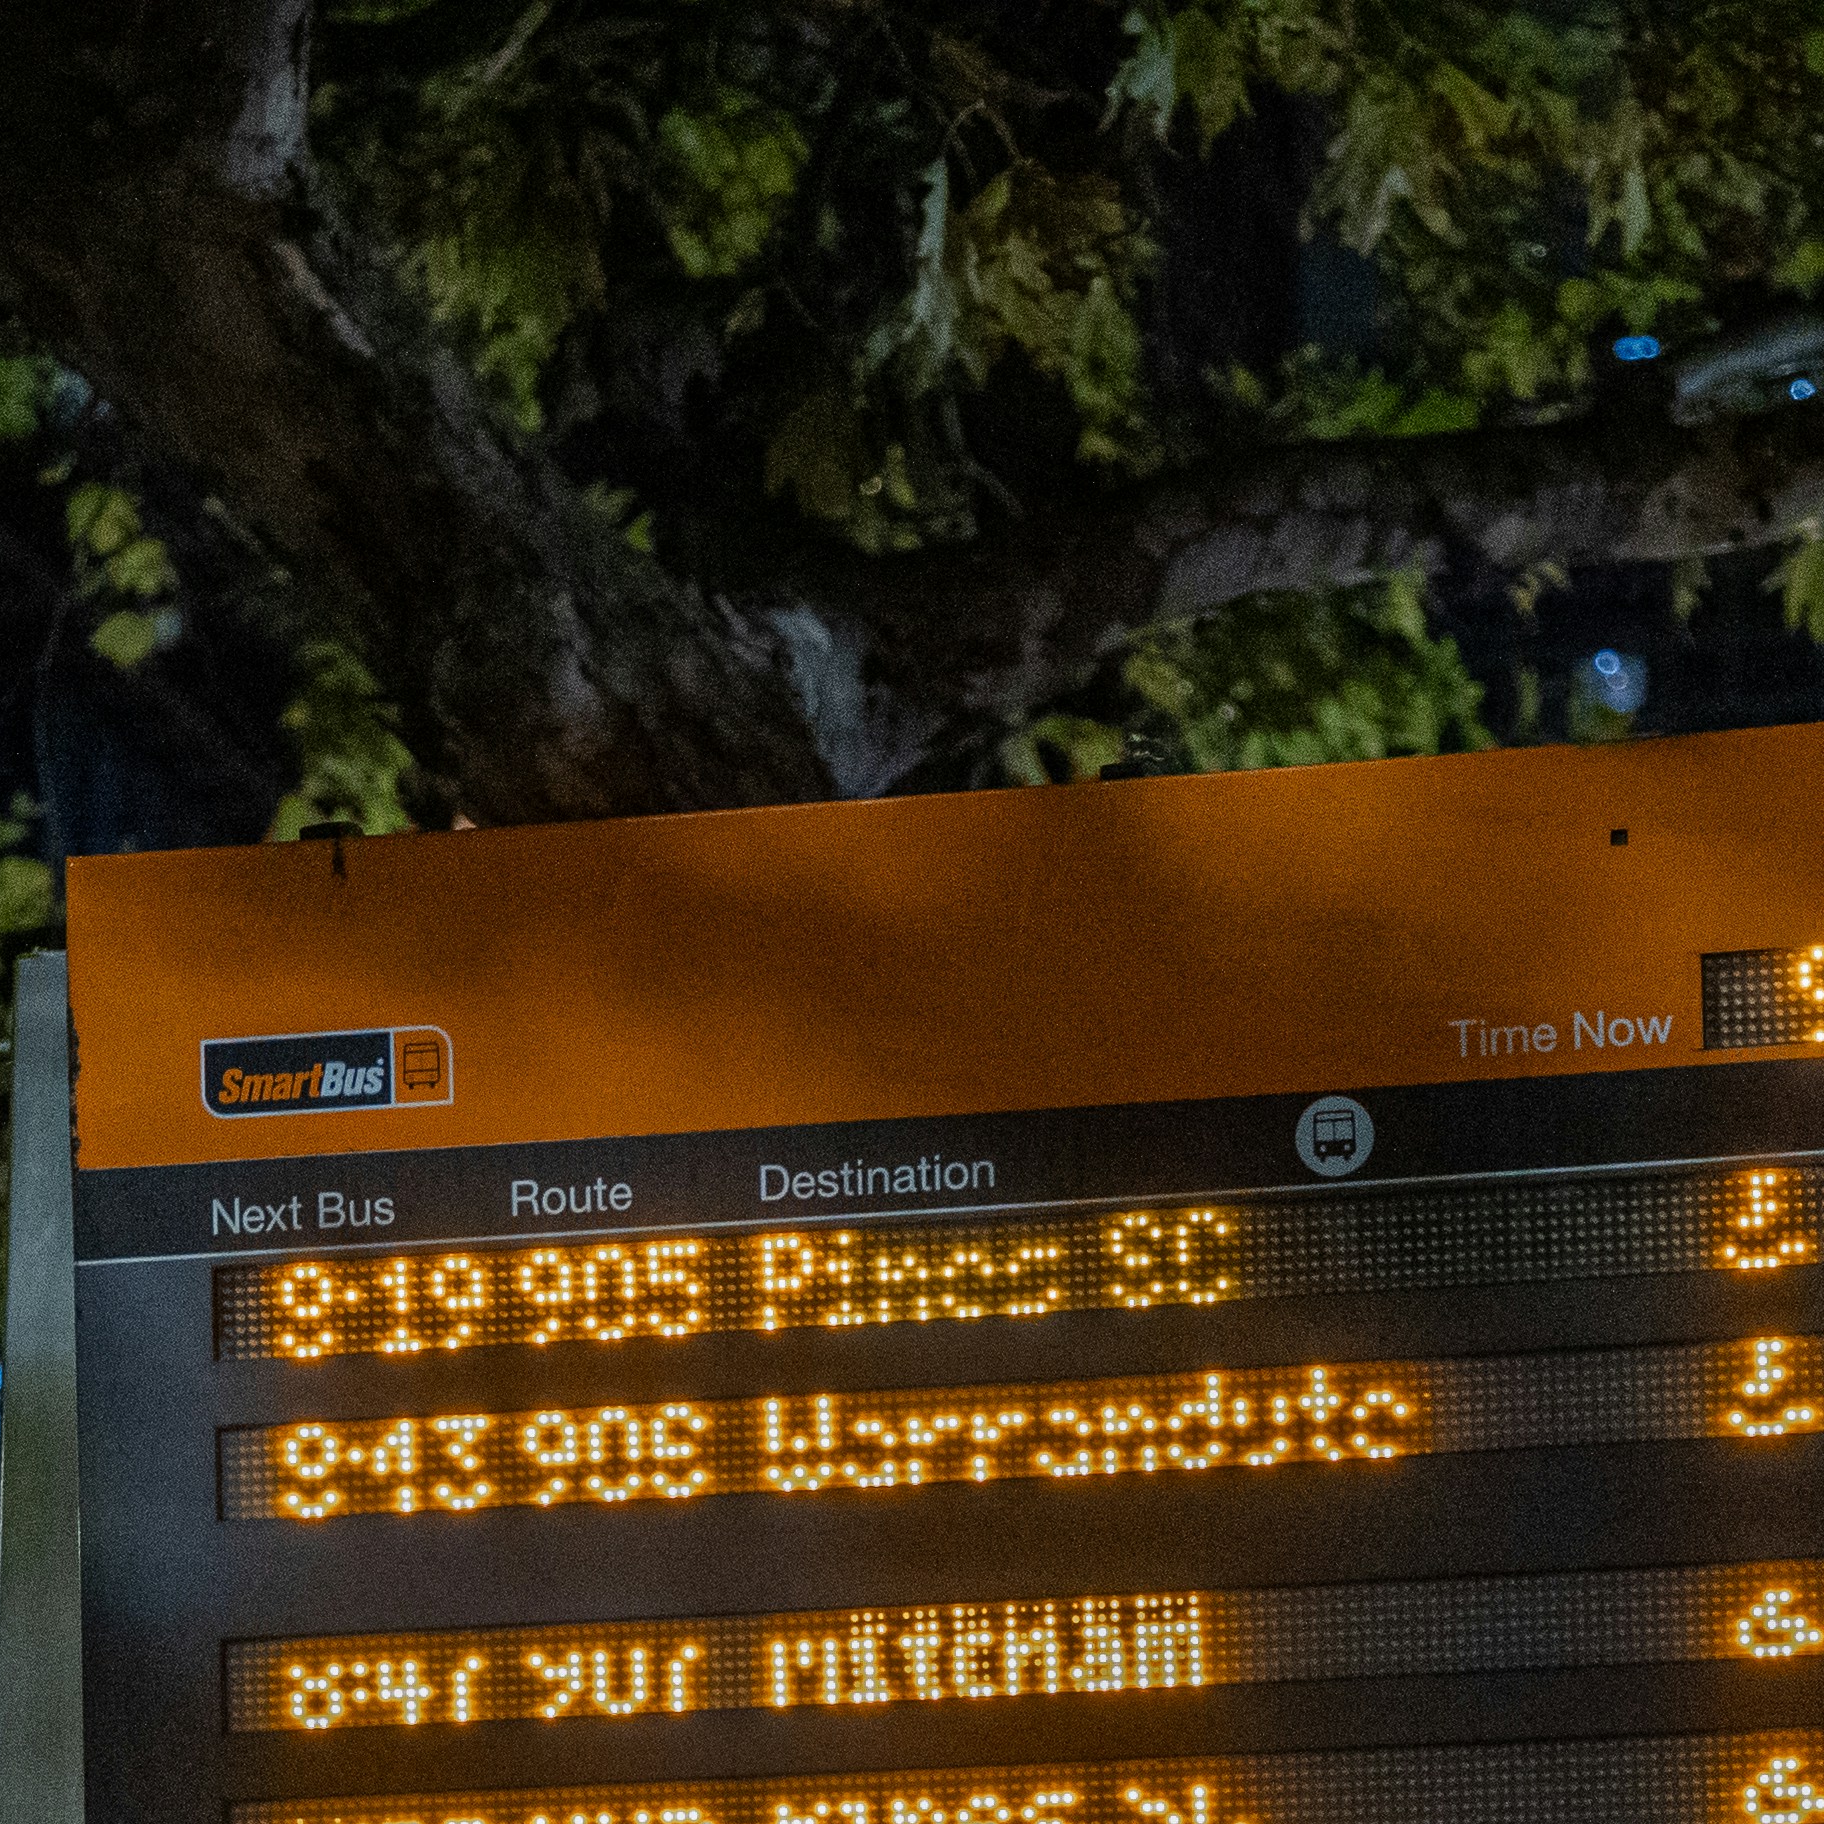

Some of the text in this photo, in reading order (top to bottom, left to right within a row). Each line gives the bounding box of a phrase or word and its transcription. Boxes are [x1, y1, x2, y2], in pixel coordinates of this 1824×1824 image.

[1450, 1012, 1674, 1059] Time Now
[218, 1059, 386, 1104] SmartBus
[510, 1178, 634, 1217] Route
[759, 1155, 997, 1204] Destination
[211, 1191, 397, 1236] Next Bus
